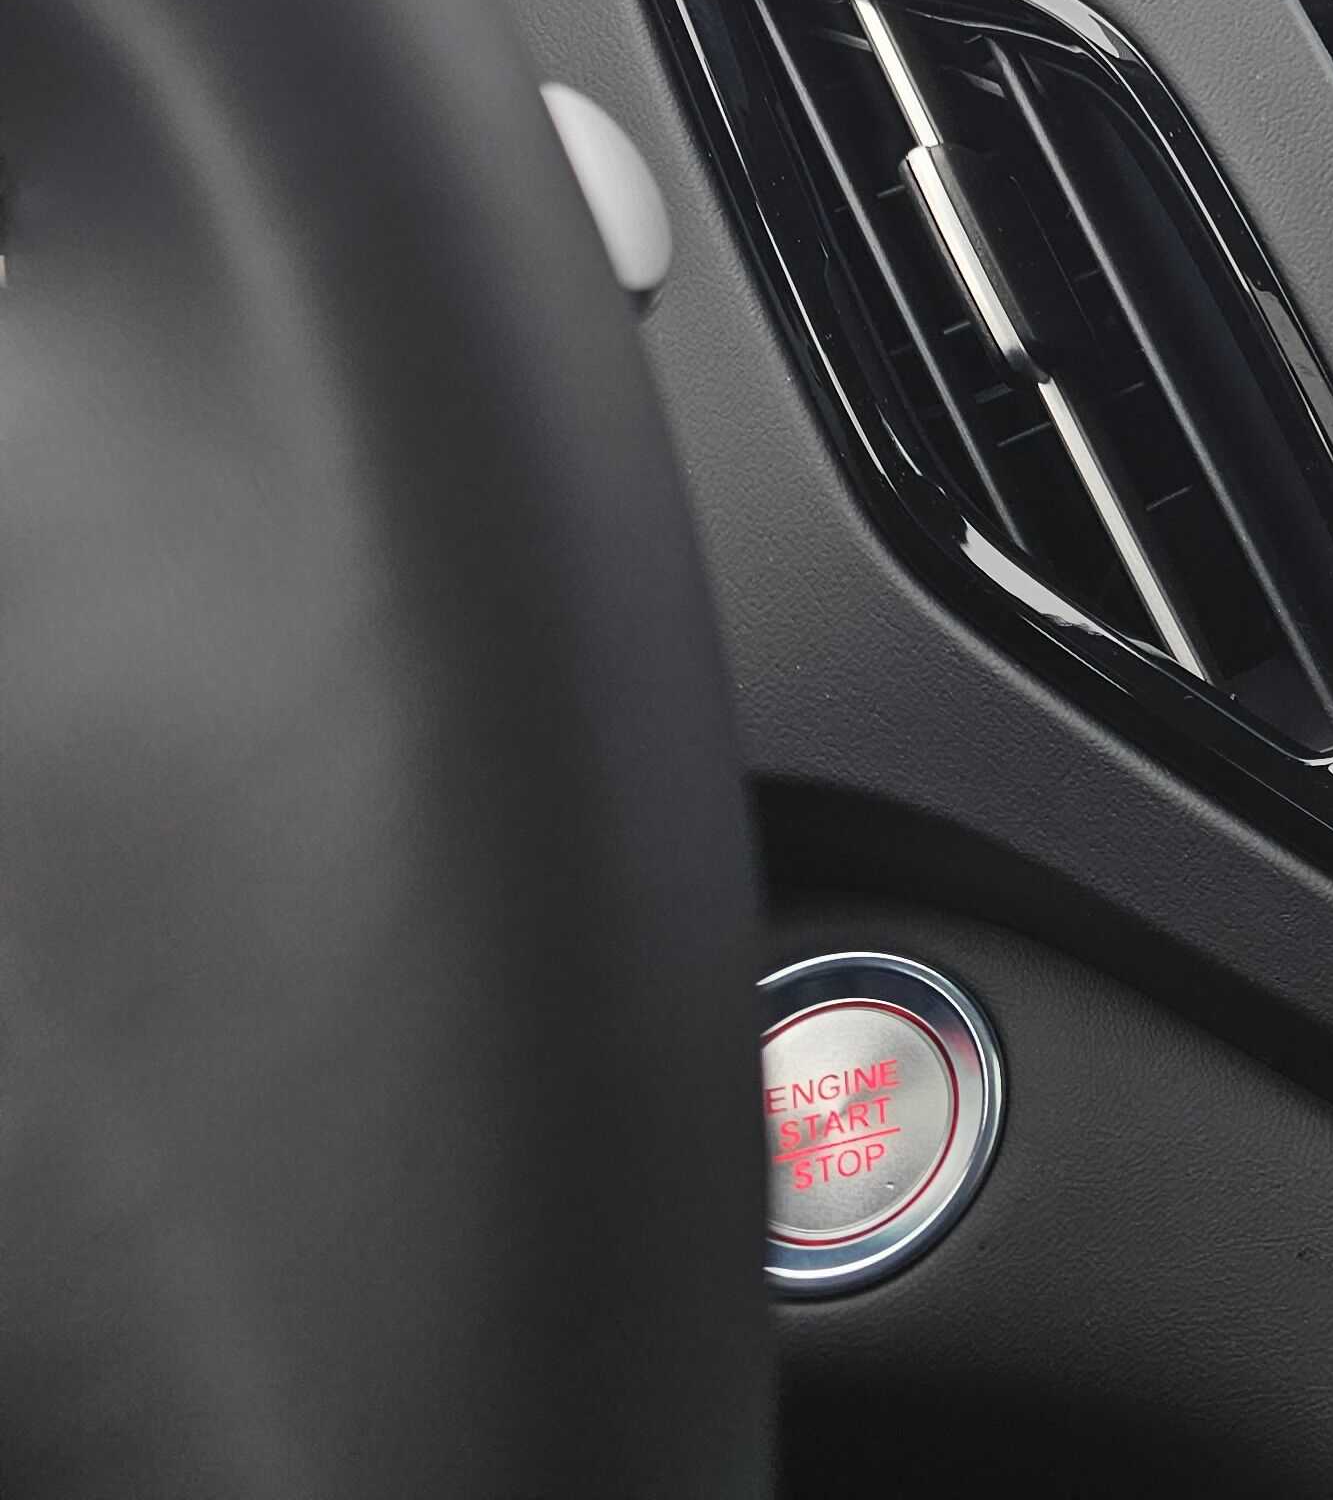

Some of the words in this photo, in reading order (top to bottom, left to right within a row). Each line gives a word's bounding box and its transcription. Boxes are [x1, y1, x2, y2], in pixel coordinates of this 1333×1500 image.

[766, 1060, 898, 1115] ENGINE
[779, 1097, 892, 1149] START
[792, 1143, 885, 1192] STOP
